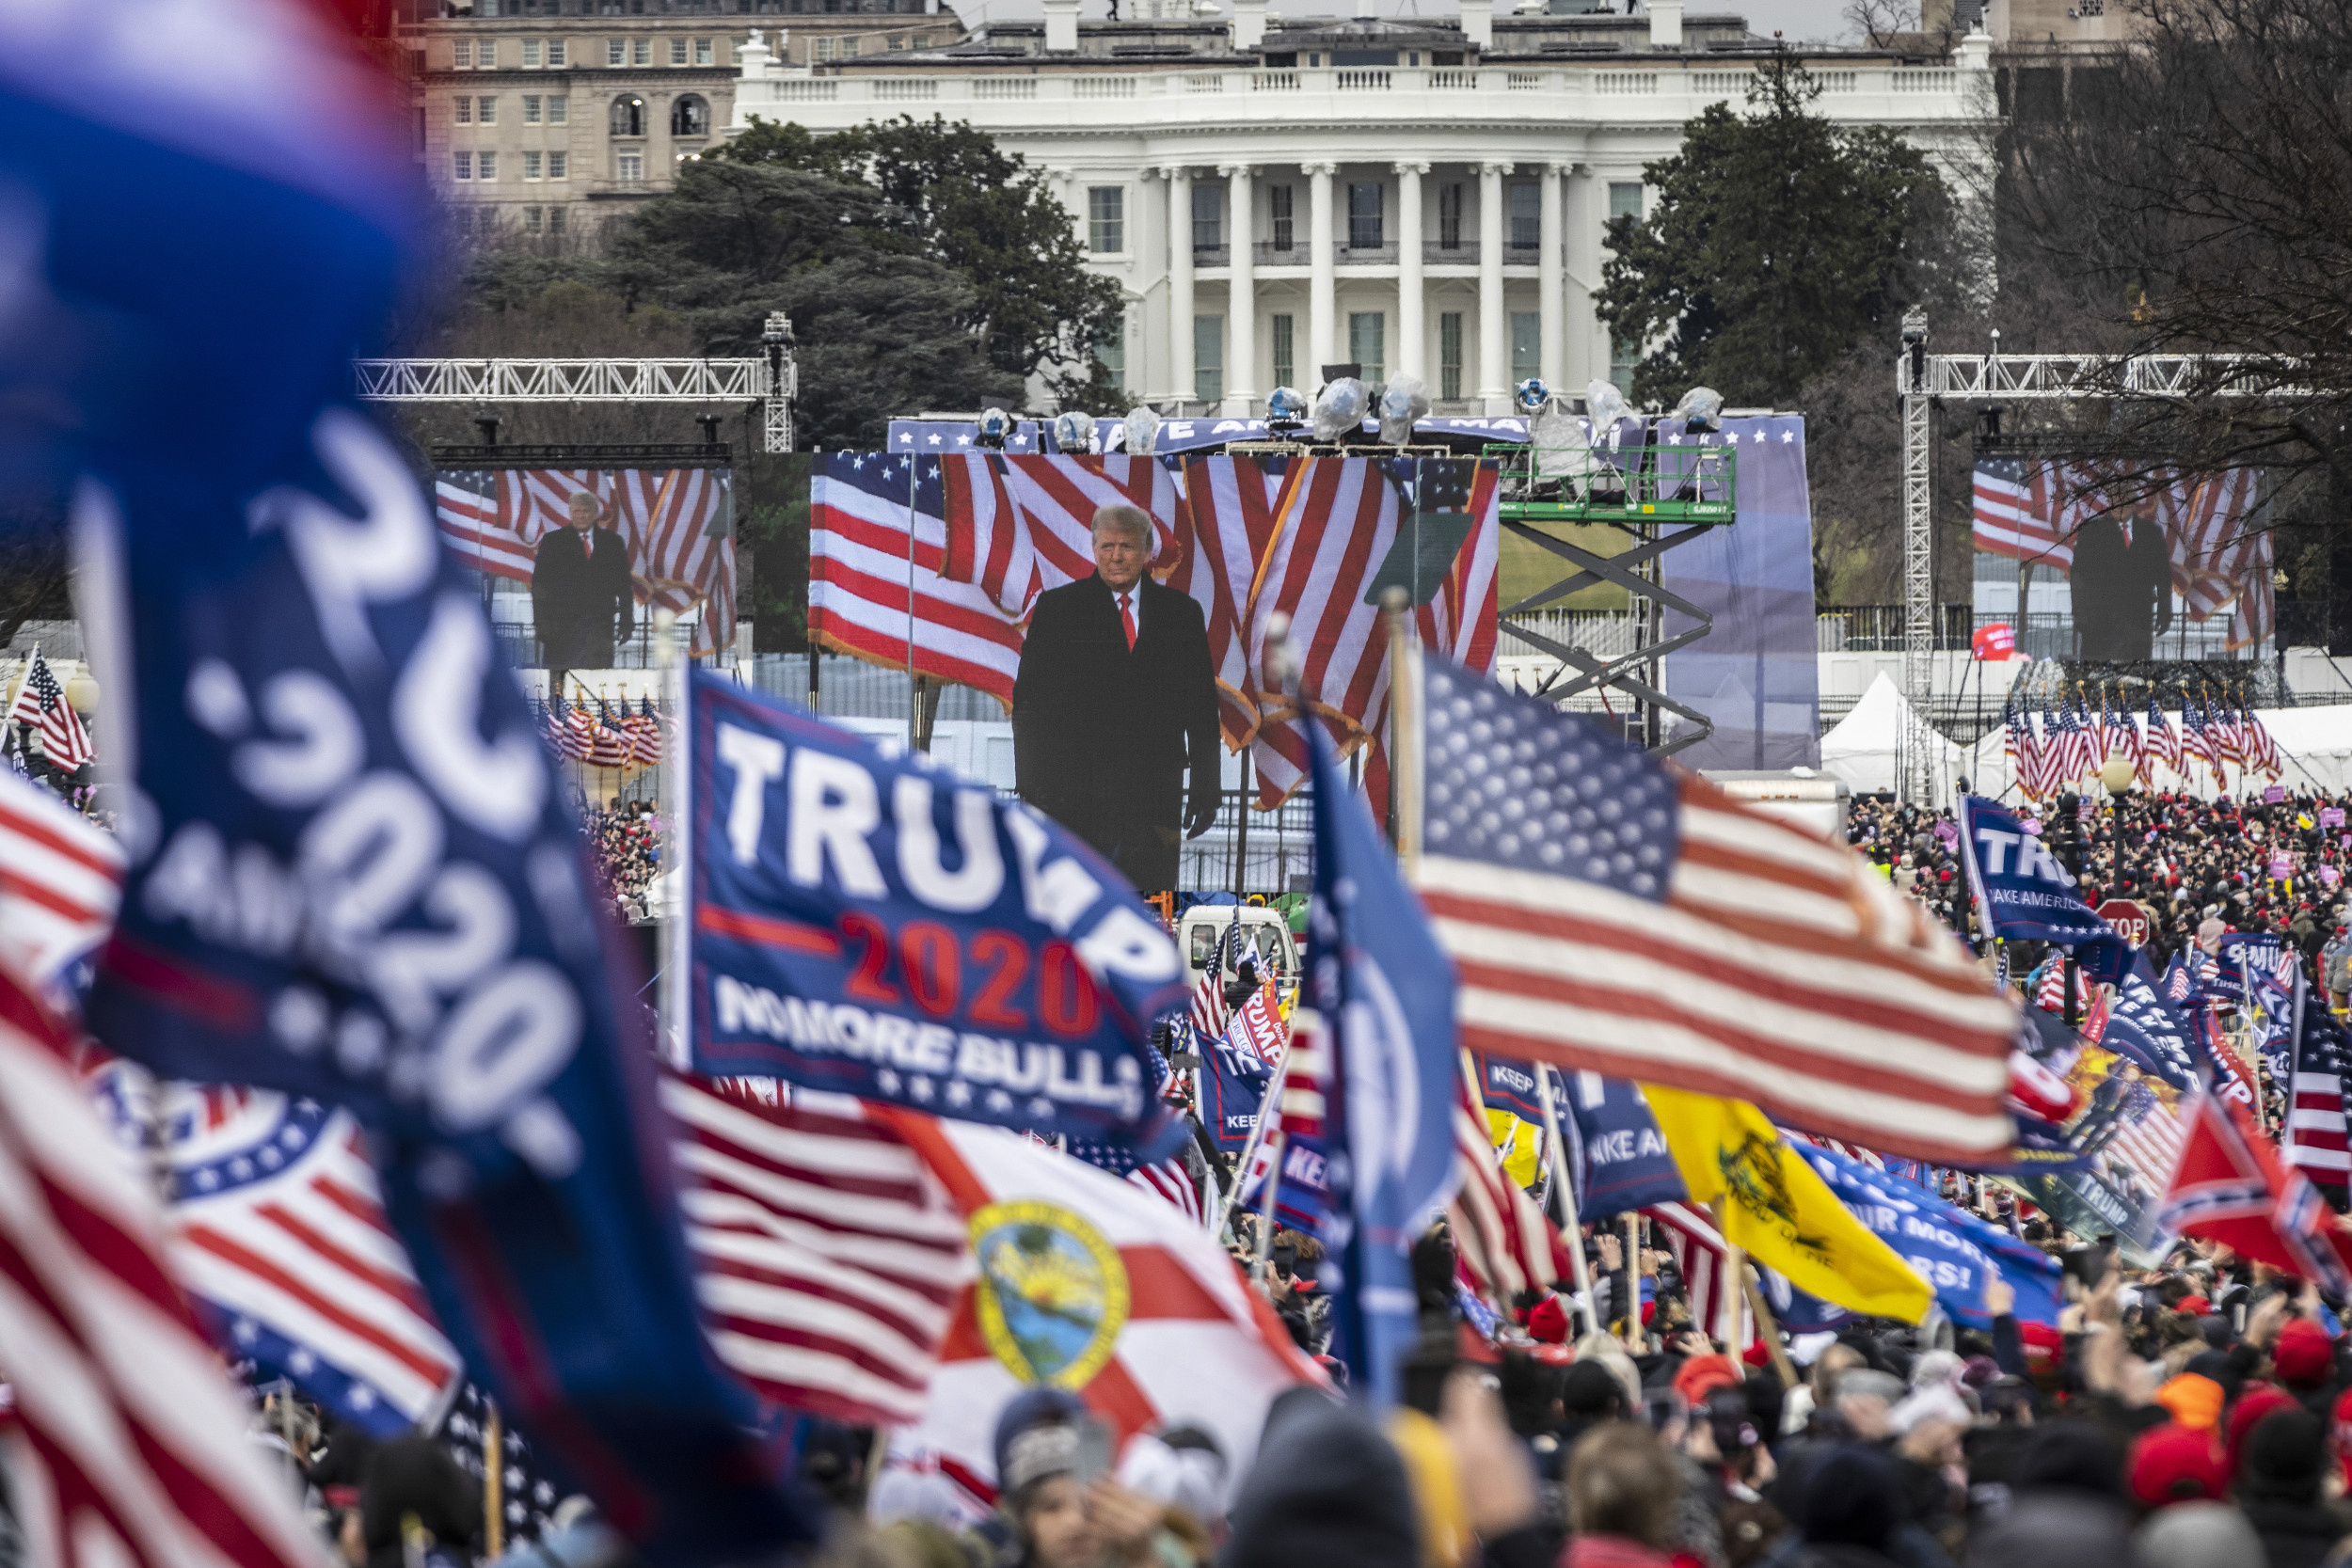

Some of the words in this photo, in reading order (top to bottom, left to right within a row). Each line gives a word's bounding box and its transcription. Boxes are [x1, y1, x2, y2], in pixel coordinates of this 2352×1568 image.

[1087, 420, 1195, 454] SAE
[841, 909, 1103, 1040] 2020
[1272, 1022, 1288, 1046] DONA
[1491, 1065, 1534, 1093] KEEP
[1227, 1114, 1262, 1129] KEE
[2075, 1173, 2129, 1227] TRUMP
